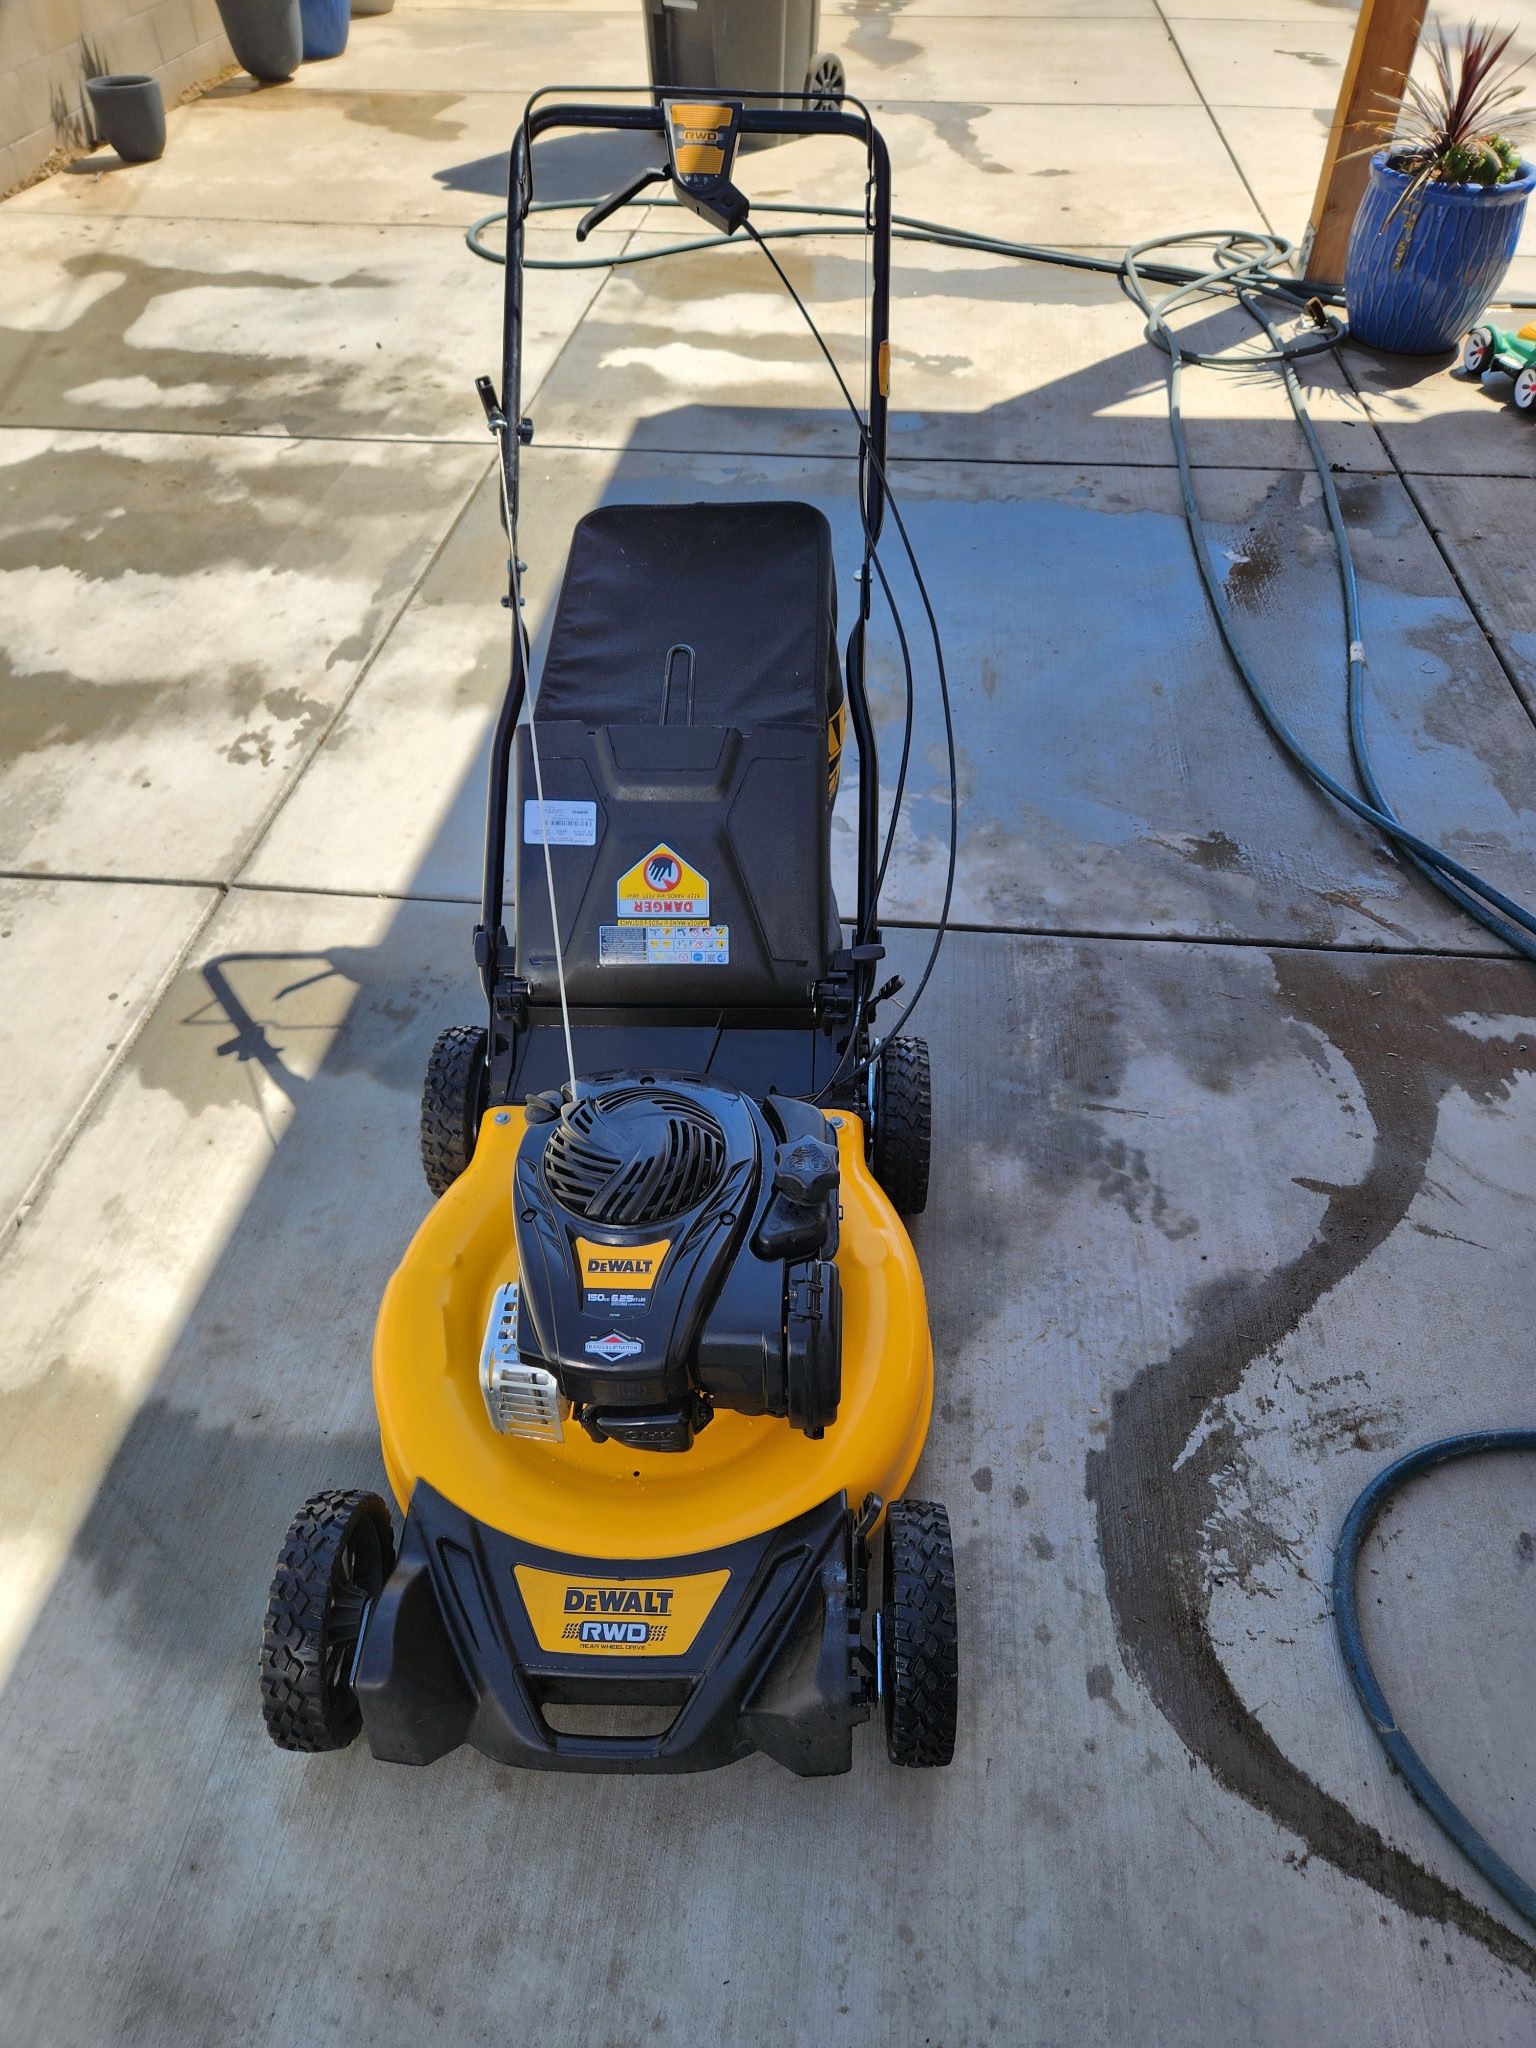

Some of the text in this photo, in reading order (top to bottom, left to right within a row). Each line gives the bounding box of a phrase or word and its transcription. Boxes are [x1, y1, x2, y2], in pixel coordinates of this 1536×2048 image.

[685, 132, 717, 140] RWD
[633, 901, 693, 913] DANGER
[588, 1260, 653, 1272] DEWALT
[564, 1589, 673, 1613] DEWALT
[582, 1622, 647, 1642] RWD
